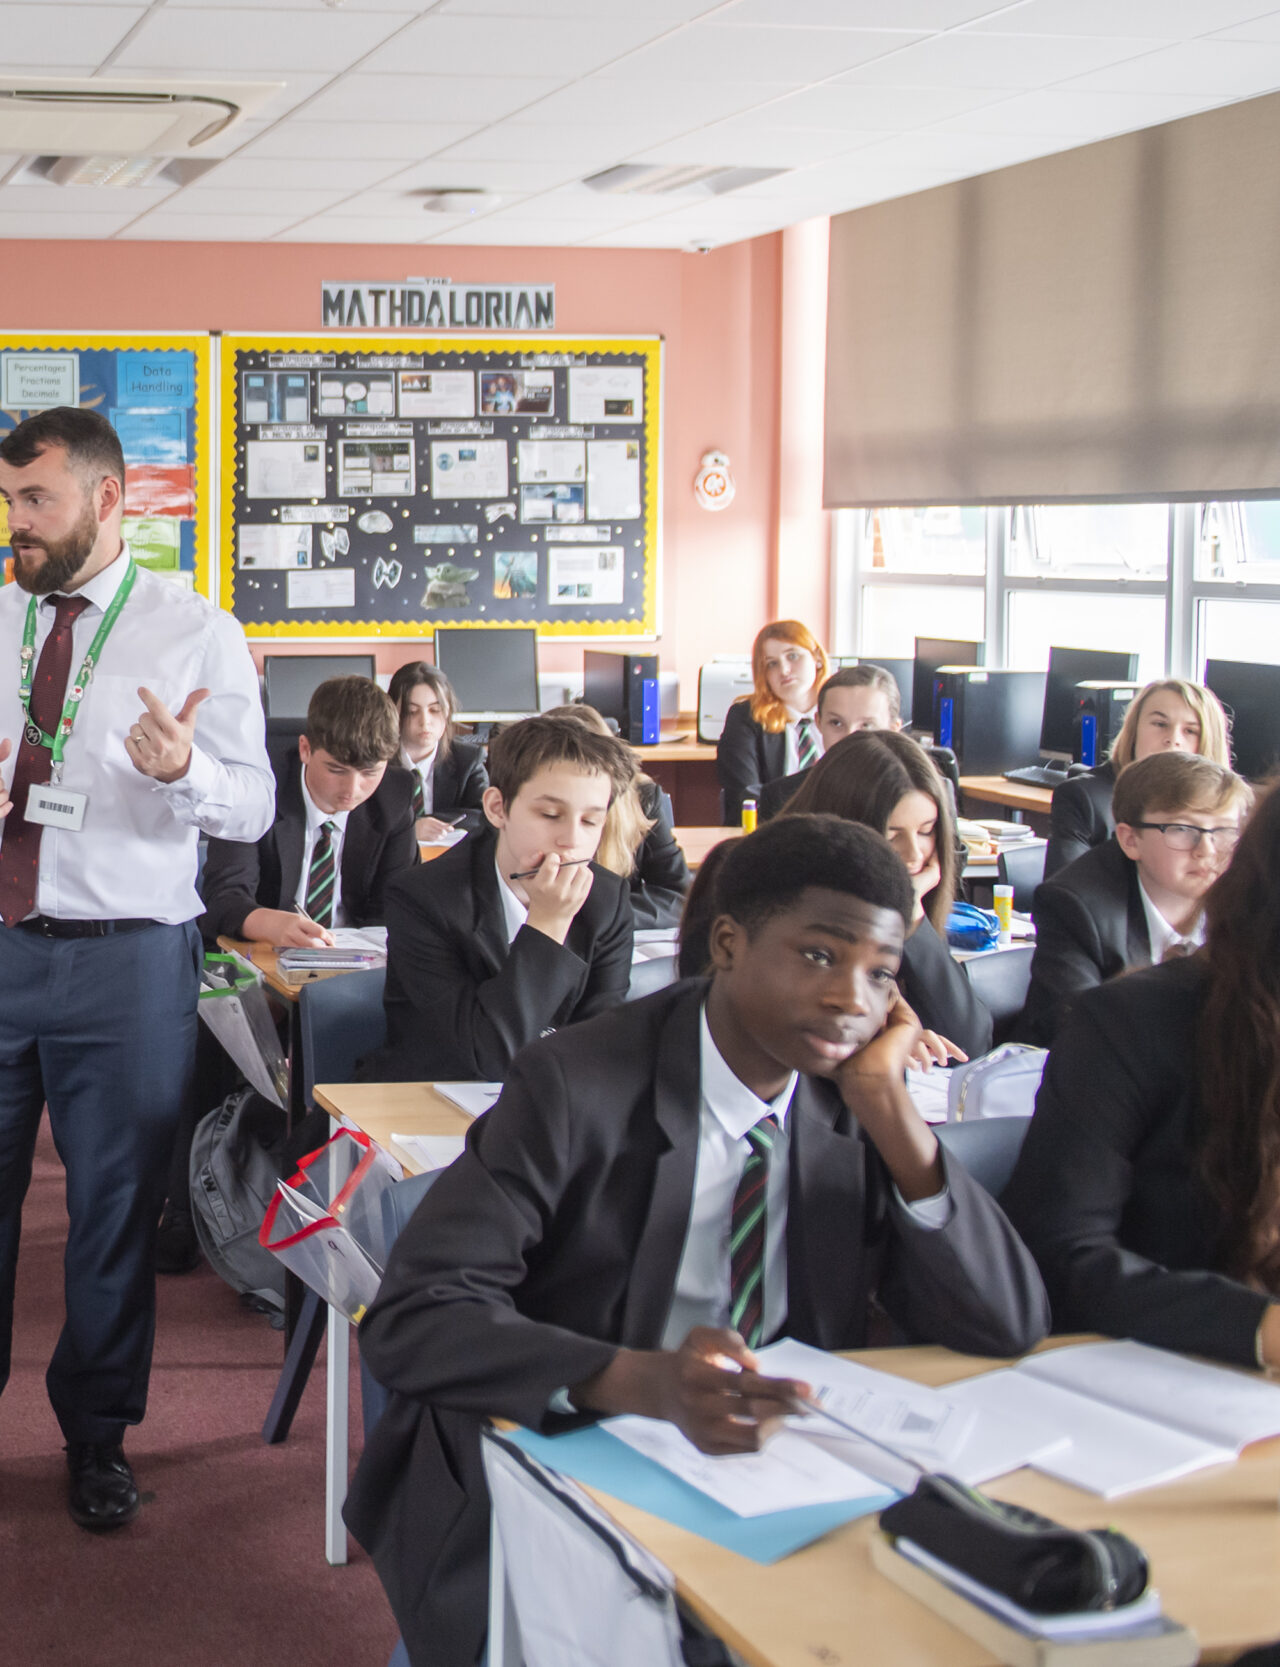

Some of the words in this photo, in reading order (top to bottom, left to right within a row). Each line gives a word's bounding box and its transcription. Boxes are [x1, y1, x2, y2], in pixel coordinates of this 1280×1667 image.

[322, 289, 554, 328] MATHDALORIAN
[14, 363, 67, 374] Percentages
[143, 365, 172, 377] Data
[20, 376, 61, 385] Fractions
[131, 381, 183, 396] Handling
